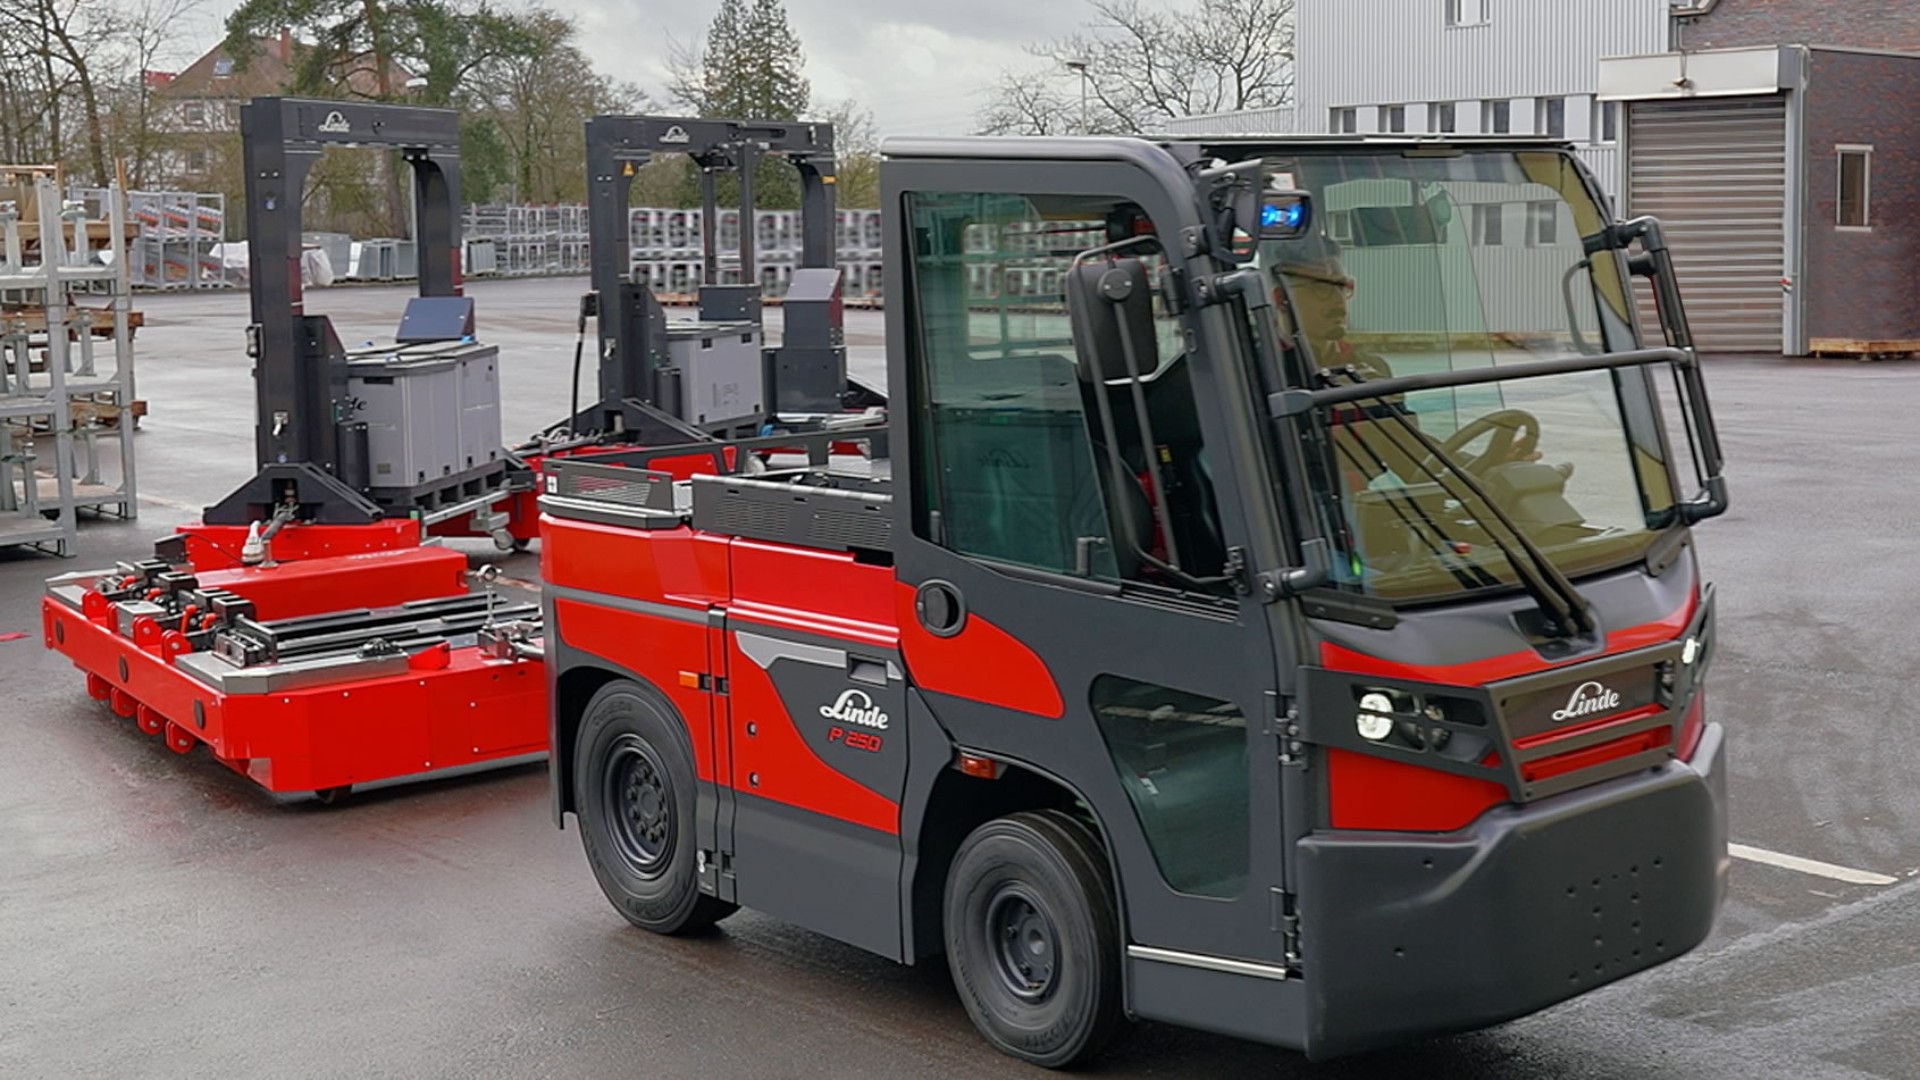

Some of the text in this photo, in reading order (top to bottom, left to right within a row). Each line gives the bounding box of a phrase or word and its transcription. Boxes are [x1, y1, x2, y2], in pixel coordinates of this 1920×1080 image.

[819, 689, 889, 729] Linde
[1552, 681, 1619, 720] Linde
[828, 727, 882, 752] P 250
